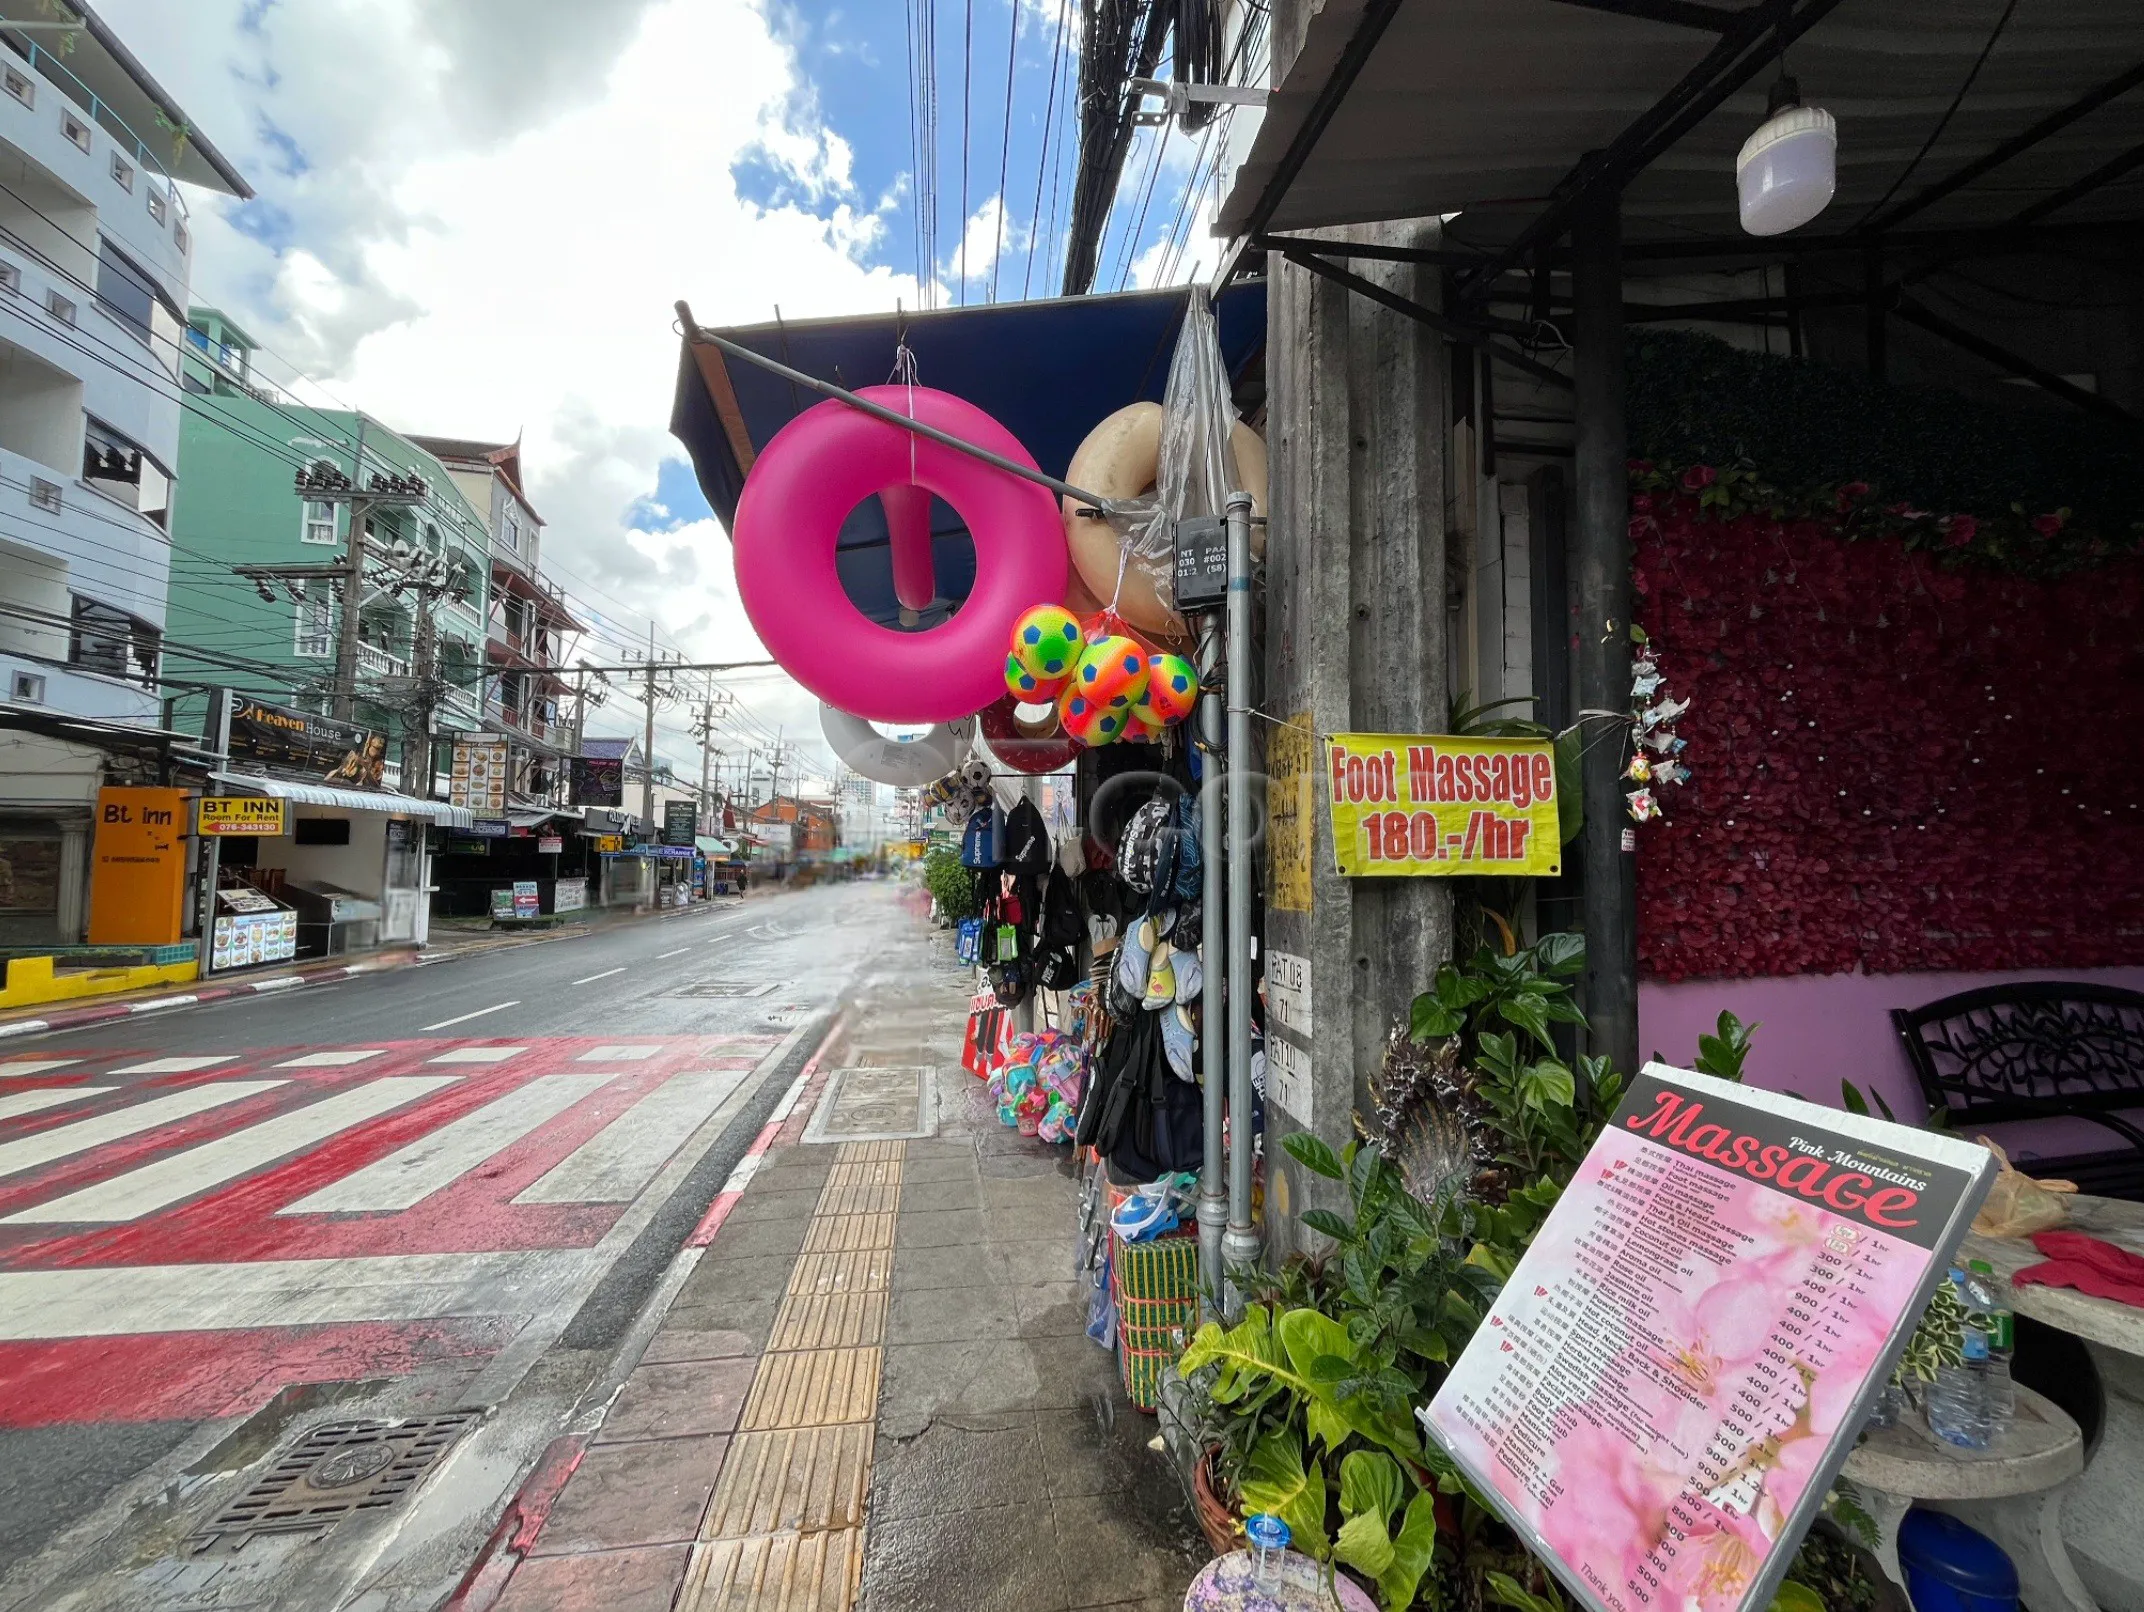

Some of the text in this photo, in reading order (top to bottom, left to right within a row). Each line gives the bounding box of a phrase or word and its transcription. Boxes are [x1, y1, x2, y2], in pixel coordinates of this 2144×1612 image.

[1179, 554, 1227, 567] 030 #002
[1180, 546, 1226, 558] NT PAA
[305, 721, 342, 741] House
[1330, 746, 1397, 803] Foot
[1407, 745, 1553, 809] Massage
[103, 804, 172, 826] Bt inn
[202, 813, 280, 822] Room For Rent
[203, 801, 280, 813] BT INN
[973, 831, 982, 864] Supreme
[1015, 835, 1036, 863] Supreme
[1362, 811, 1530, 861] 180.-/hr
[1279, 998, 1289, 1024] 71
[1673, 1159, 1737, 1190] Thai massage
[1787, 1136, 1825, 1159] Pink
[1827, 1150, 1927, 1192] Mountains
[1660, 1182, 1716, 1211] Oil massage
[1666, 1170, 1731, 1203] Foot massage
[1647, 1203, 1667, 1217] Thai
[1667, 1213, 1675, 1222] &
[1677, 1218, 1691, 1229] Oil
[1691, 1226, 1735, 1252] massage
[1654, 1192, 1674, 1207] Foot
[1675, 1202, 1683, 1211] &
[1684, 1207, 1710, 1223] Head
[1710, 1219, 1755, 1245] massage
[1633, 1226, 1684, 1256] Coconut oil
[1640, 1214, 1657, 1227] Hot
[1657, 1224, 1688, 1243] stones
[1688, 1240, 1732, 1265] massage
[1619, 1248, 1648, 1268] Aroma
[1648, 1265, 1662, 1276] oil
[1625, 1236, 1679, 1270] Lemongrass
[1680, 1267, 1694, 1277] oil
[1817, 1251, 1843, 1266] 300
[1612, 1259, 1647, 1283] Rose oil
[1809, 1264, 1834, 1280] 300
[1598, 1281, 1651, 1318] Rice milk oil
[1605, 1270, 1654, 1303] Jasmine oil
[1802, 1279, 1827, 1294] 400
[1794, 1292, 1818, 1308] 900
[1591, 1293, 1624, 1317] Powder
[1624, 1315, 1664, 1347] massage
[1786, 1306, 1811, 1322] 400
[1584, 1305, 1649, 1352] Hot coconut oil
[1778, 1320, 1802, 1336] 400
[1569, 1328, 1631, 1377] Sport massage
[1770, 1334, 1795, 1350] 400
[1563, 1339, 1591, 1363] Herbal
[1590, 1361, 1629, 1394] massage
[1577, 1316, 1708, 1411] Head, Neck, Back & Shoulder
[1762, 1348, 1786, 1365] 400
[1548, 1364, 1567, 1382] Aloe
[1568, 1379, 1586, 1397] vera
[1754, 1362, 1778, 1379] 400
[1556, 1352, 1590, 1381] Swedish
[1590, 1379, 1629, 1416] massage
[1746, 1376, 1770, 1394] 400
[1534, 1387, 1578, 1428] Body scrub
[1541, 1375, 1603, 1430] Facial massage
[1737, 1390, 1762, 1408] 400
[1527, 1399, 1568, 1439] Foot scrub
[1729, 1403, 1753, 1423] 500
[1512, 1422, 1546, 1458] Pedicure
[1520, 1411, 1556, 1447] Manicure
[1721, 1419, 1745, 1437] 400
[1713, 1431, 1736, 1452] 500
[1505, 1435, 1540, 1474] Manicure
[1549, 1478, 1565, 1496] Gel
[1705, 1446, 1728, 1467] 900
[1497, 1447, 1531, 1486] Pedicure
[1539, 1489, 1555, 1507] Gel
[1688, 1475, 1712, 1497] 500
[1697, 1461, 1720, 1485] 900
[1679, 1490, 1703, 1512] 500
[1671, 1504, 1694, 1527] 800
[1662, 1519, 1686, 1542] 400
[1654, 1533, 1676, 1558] 300
[1645, 1549, 1667, 1573] 300
[1580, 1562, 1626, 1612] Thank you
[1636, 1564, 1659, 1588] 500
[1627, 1579, 1650, 1604] 500
